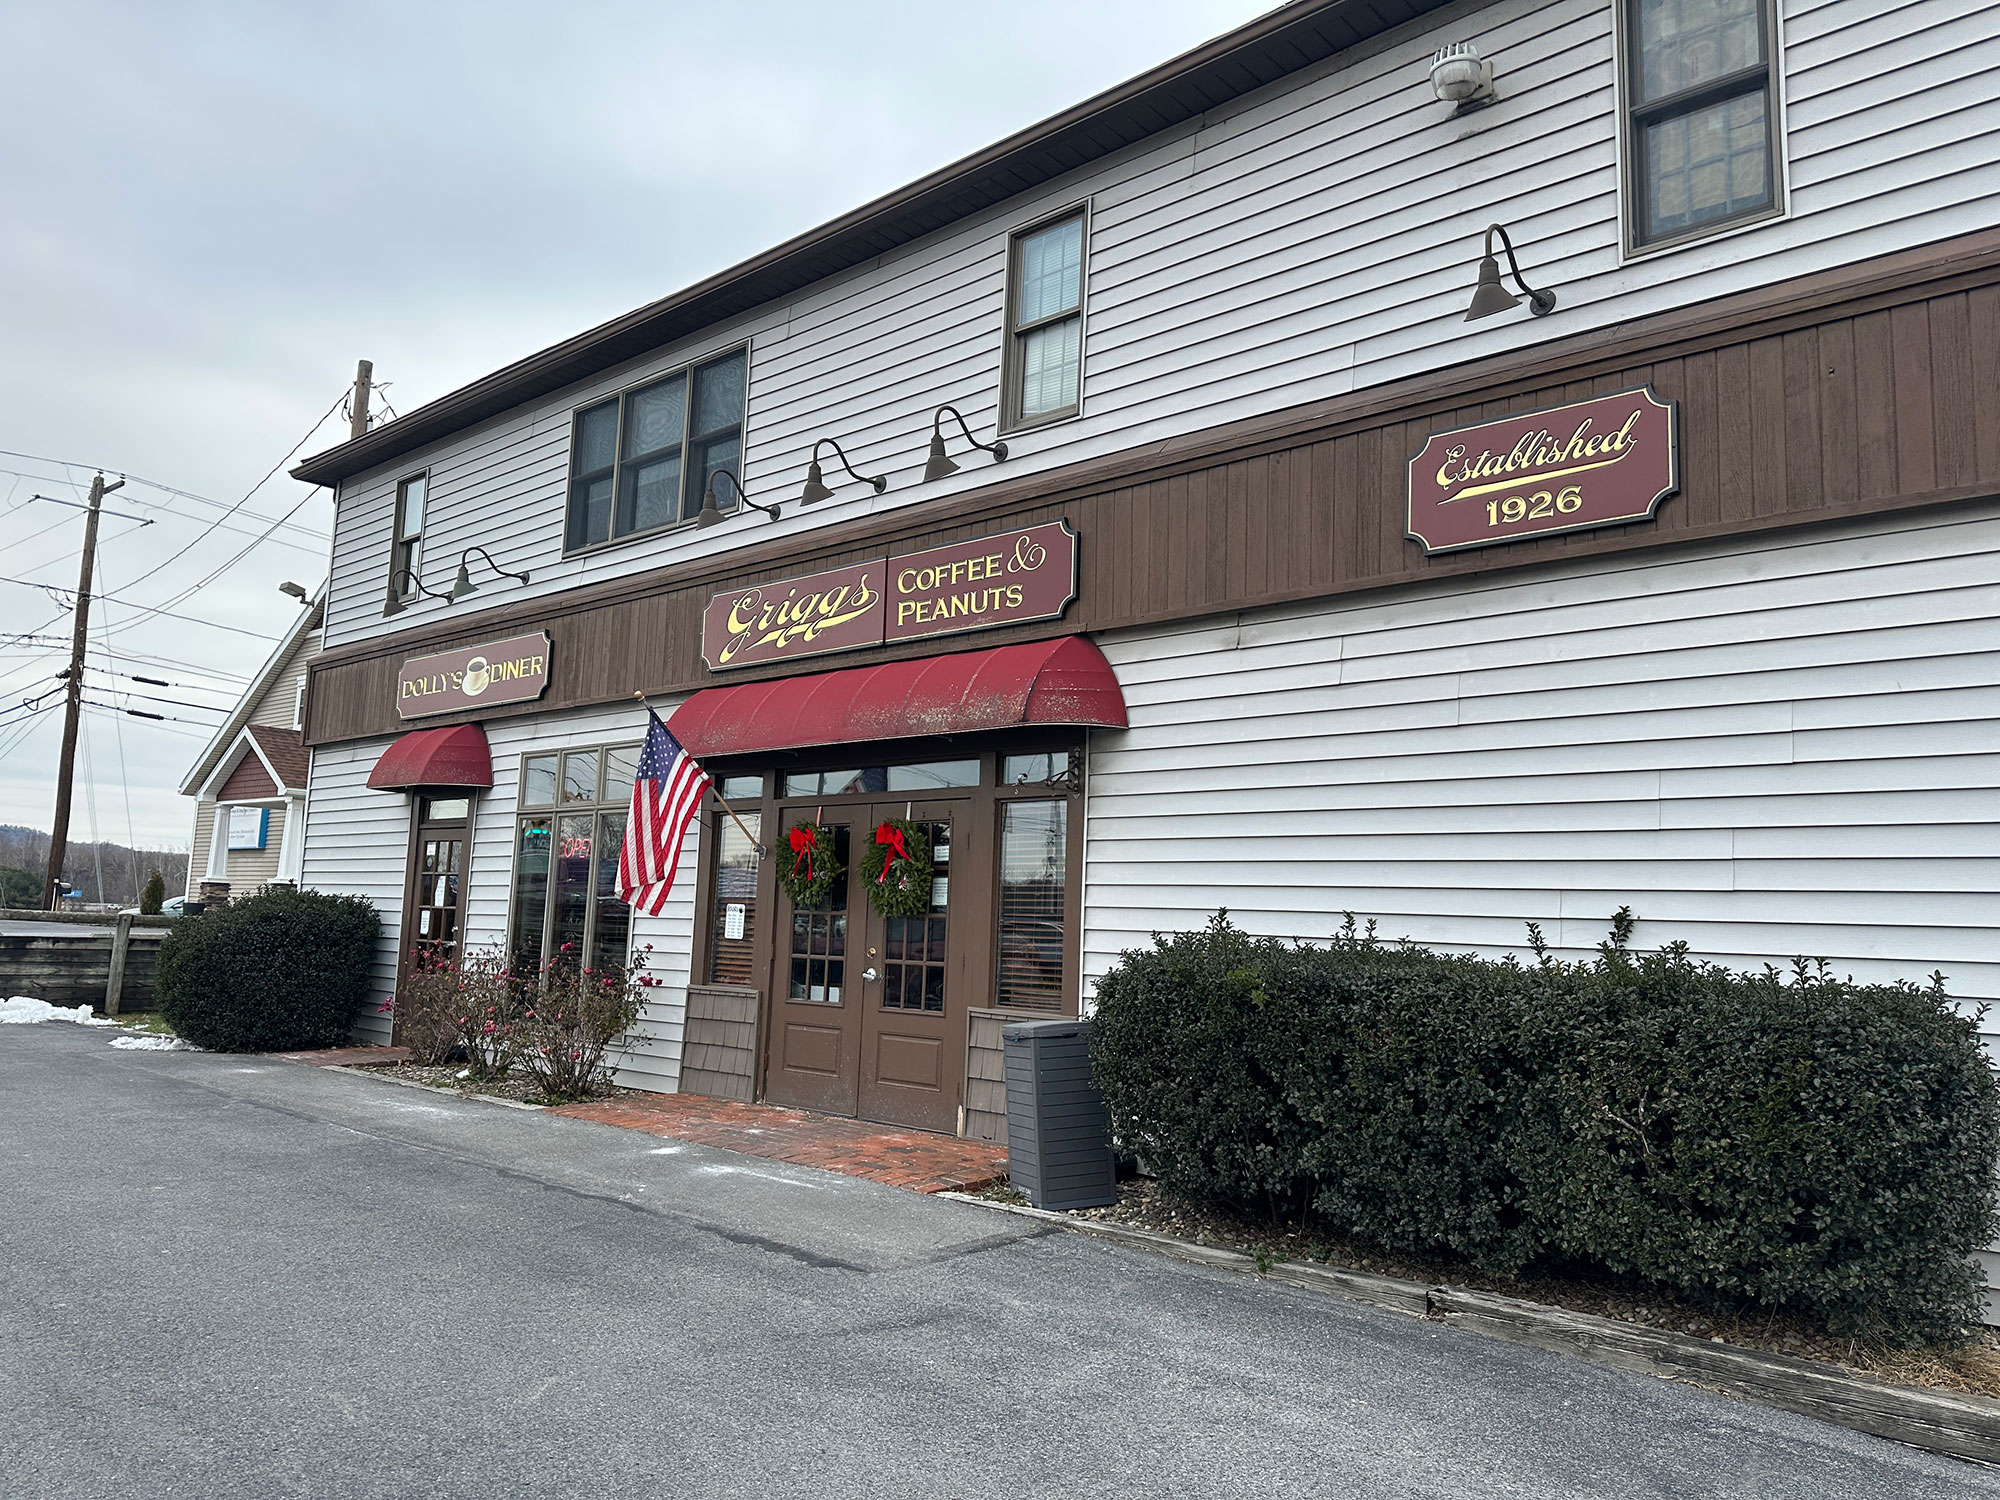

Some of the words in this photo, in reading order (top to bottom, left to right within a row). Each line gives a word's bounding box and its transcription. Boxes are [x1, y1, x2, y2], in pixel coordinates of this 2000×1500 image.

[1435, 409, 1642, 490] Established
[1486, 484, 1583, 527] 1926
[897, 552, 1003, 595] COFFEE
[1007, 535, 1047, 573] &
[719, 573, 879, 663] Griggs
[897, 583, 1024, 627] PEANUTS
[402, 671, 463, 699] DOLLY'S
[490, 656, 543, 684] DINER
